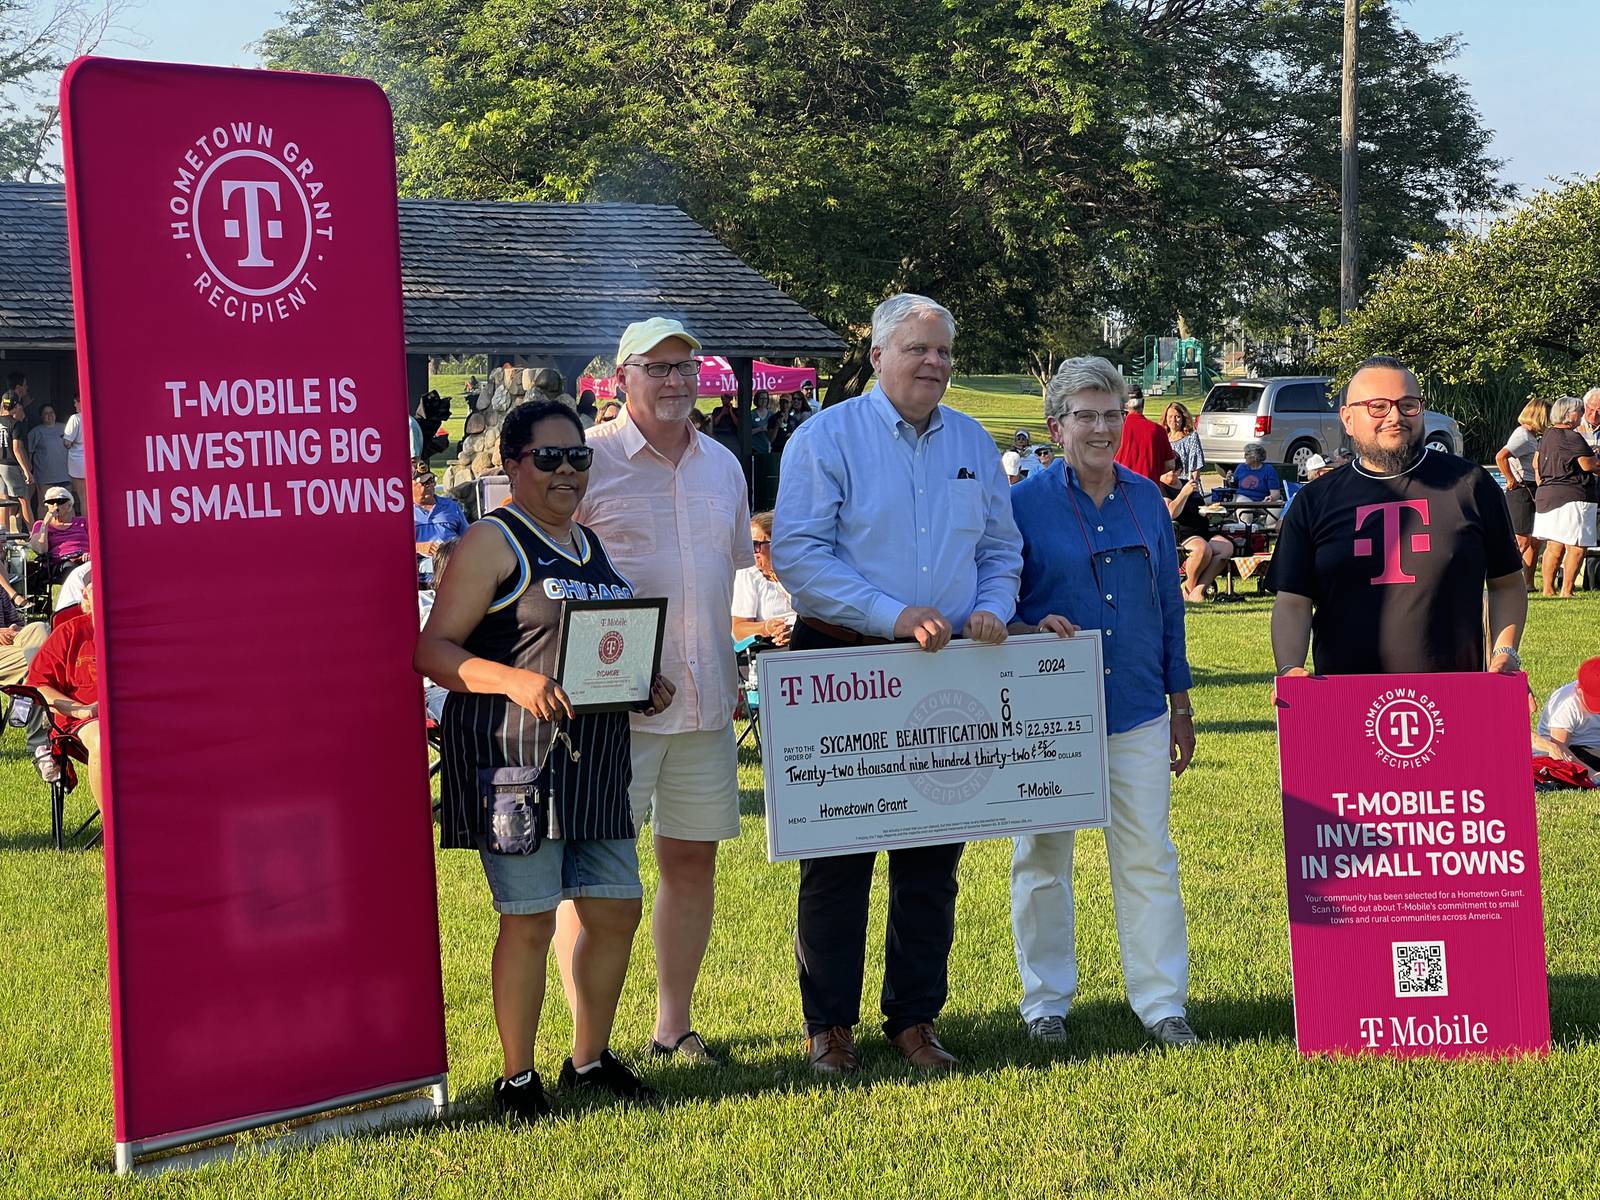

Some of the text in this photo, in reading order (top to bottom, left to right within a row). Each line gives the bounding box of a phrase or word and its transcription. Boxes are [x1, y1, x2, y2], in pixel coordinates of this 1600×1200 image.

[170, 122, 333, 240] HOMETOWN GRANT
[222, 180, 283, 267] T
[194, 272, 318, 323] RECIPIENT
[165, 377, 357, 418] T-MOBILE IS
[720, 372, 776, 391] Mile
[145, 427, 382, 472] INVESTING BIG
[126, 477, 405, 527] IN SMALL TOWNS
[1354, 499, 1430, 585] T
[1038, 658, 1065, 673] 2024
[780, 670, 902, 706] T Mobile
[1365, 688, 1444, 737] HOMETOWN GRANT
[820, 722, 998, 754] SYCAMORE BEAUTIFICATION
[1390, 711, 1419, 747] T
[784, 754, 804, 762] ORDER
[785, 763, 853, 787] Twenty-two
[857, 755, 906, 776] thousand
[910, 757, 929, 771] nine
[932, 751, 971, 769] hundred
[975, 747, 1030, 769] thirty-two
[1376, 748, 1436, 769] RECIPIENT
[1017, 781, 1062, 798] T-Mobile
[1332, 789, 1485, 816] T-MOBILE IS
[820, 798, 908, 819] Hometown Grant
[1316, 819, 1506, 847] INVESTING BIG
[1301, 850, 1526, 879] IN SMALL TOWNS
[1305, 894, 1322, 902] Your
[1323, 893, 1367, 902] community
[1383, 892, 1403, 900] been
[1404, 891, 1437, 900] selected
[1439, 890, 1449, 899] for
[1457, 890, 1499, 898] Hometown
[1501, 889, 1525, 897] Grant.
[1311, 905, 1331, 913] Scan
[1341, 904, 1357, 912] find
[1396, 902, 1436, 910] T-Mobile's
[1438, 901, 1488, 909] commitment
[1499, 900, 1519, 908] small
[1330, 916, 1354, 924] towns
[1371, 915, 1389, 923] rural
[1390, 914, 1440, 922] communities
[1468, 912, 1502, 920] America.
[1360, 1014, 1488, 1047] T Mobile
